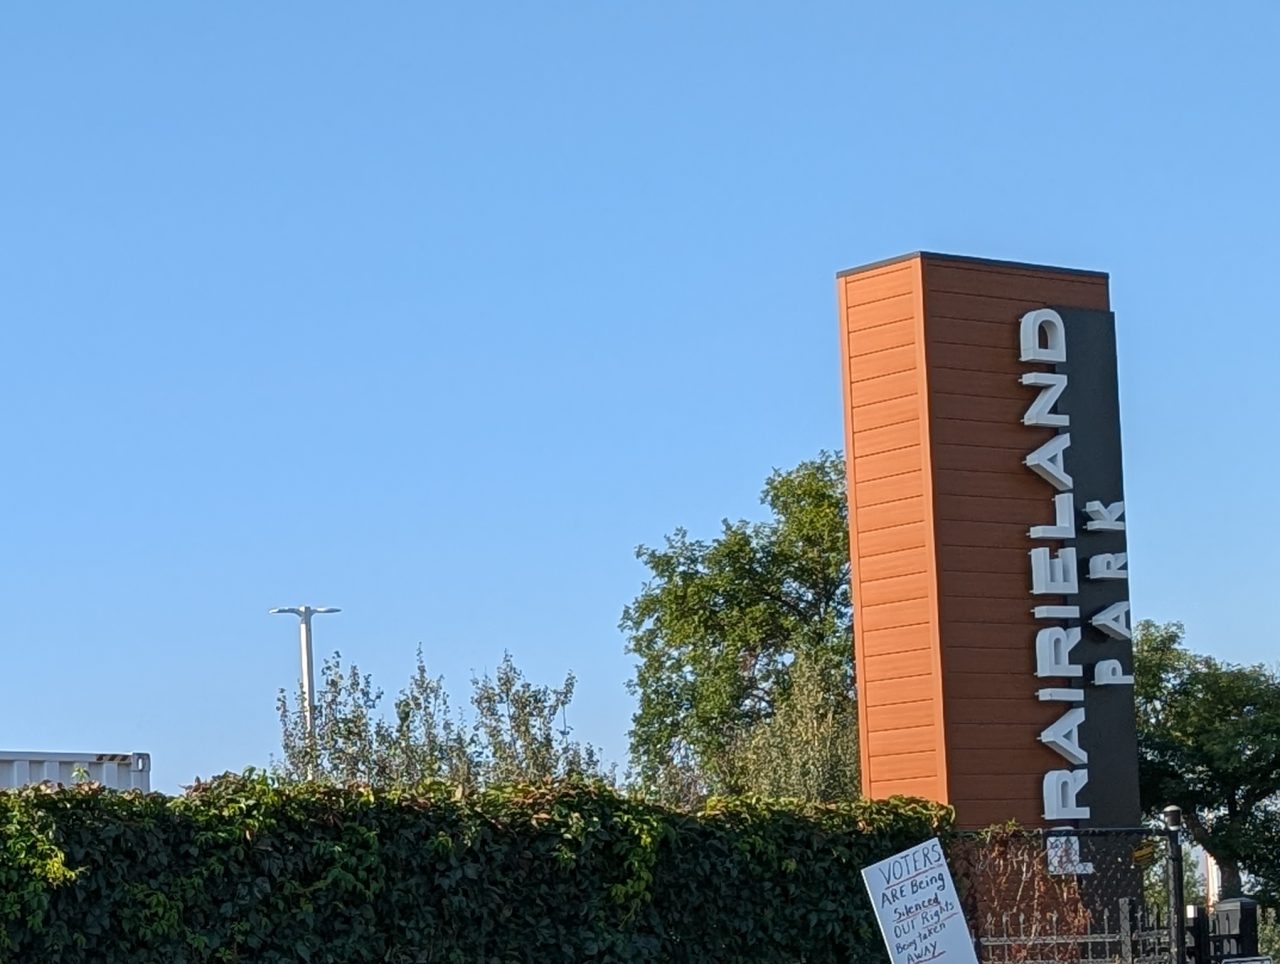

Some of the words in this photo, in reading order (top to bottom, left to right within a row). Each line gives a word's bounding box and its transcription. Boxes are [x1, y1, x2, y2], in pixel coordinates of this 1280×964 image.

[1086, 500, 1134, 685] PARK
[879, 844, 941, 885] VOTERS
[881, 885, 906, 909] ARE
[911, 873, 946, 895] Being
[907, 941, 937, 964] AWAY
